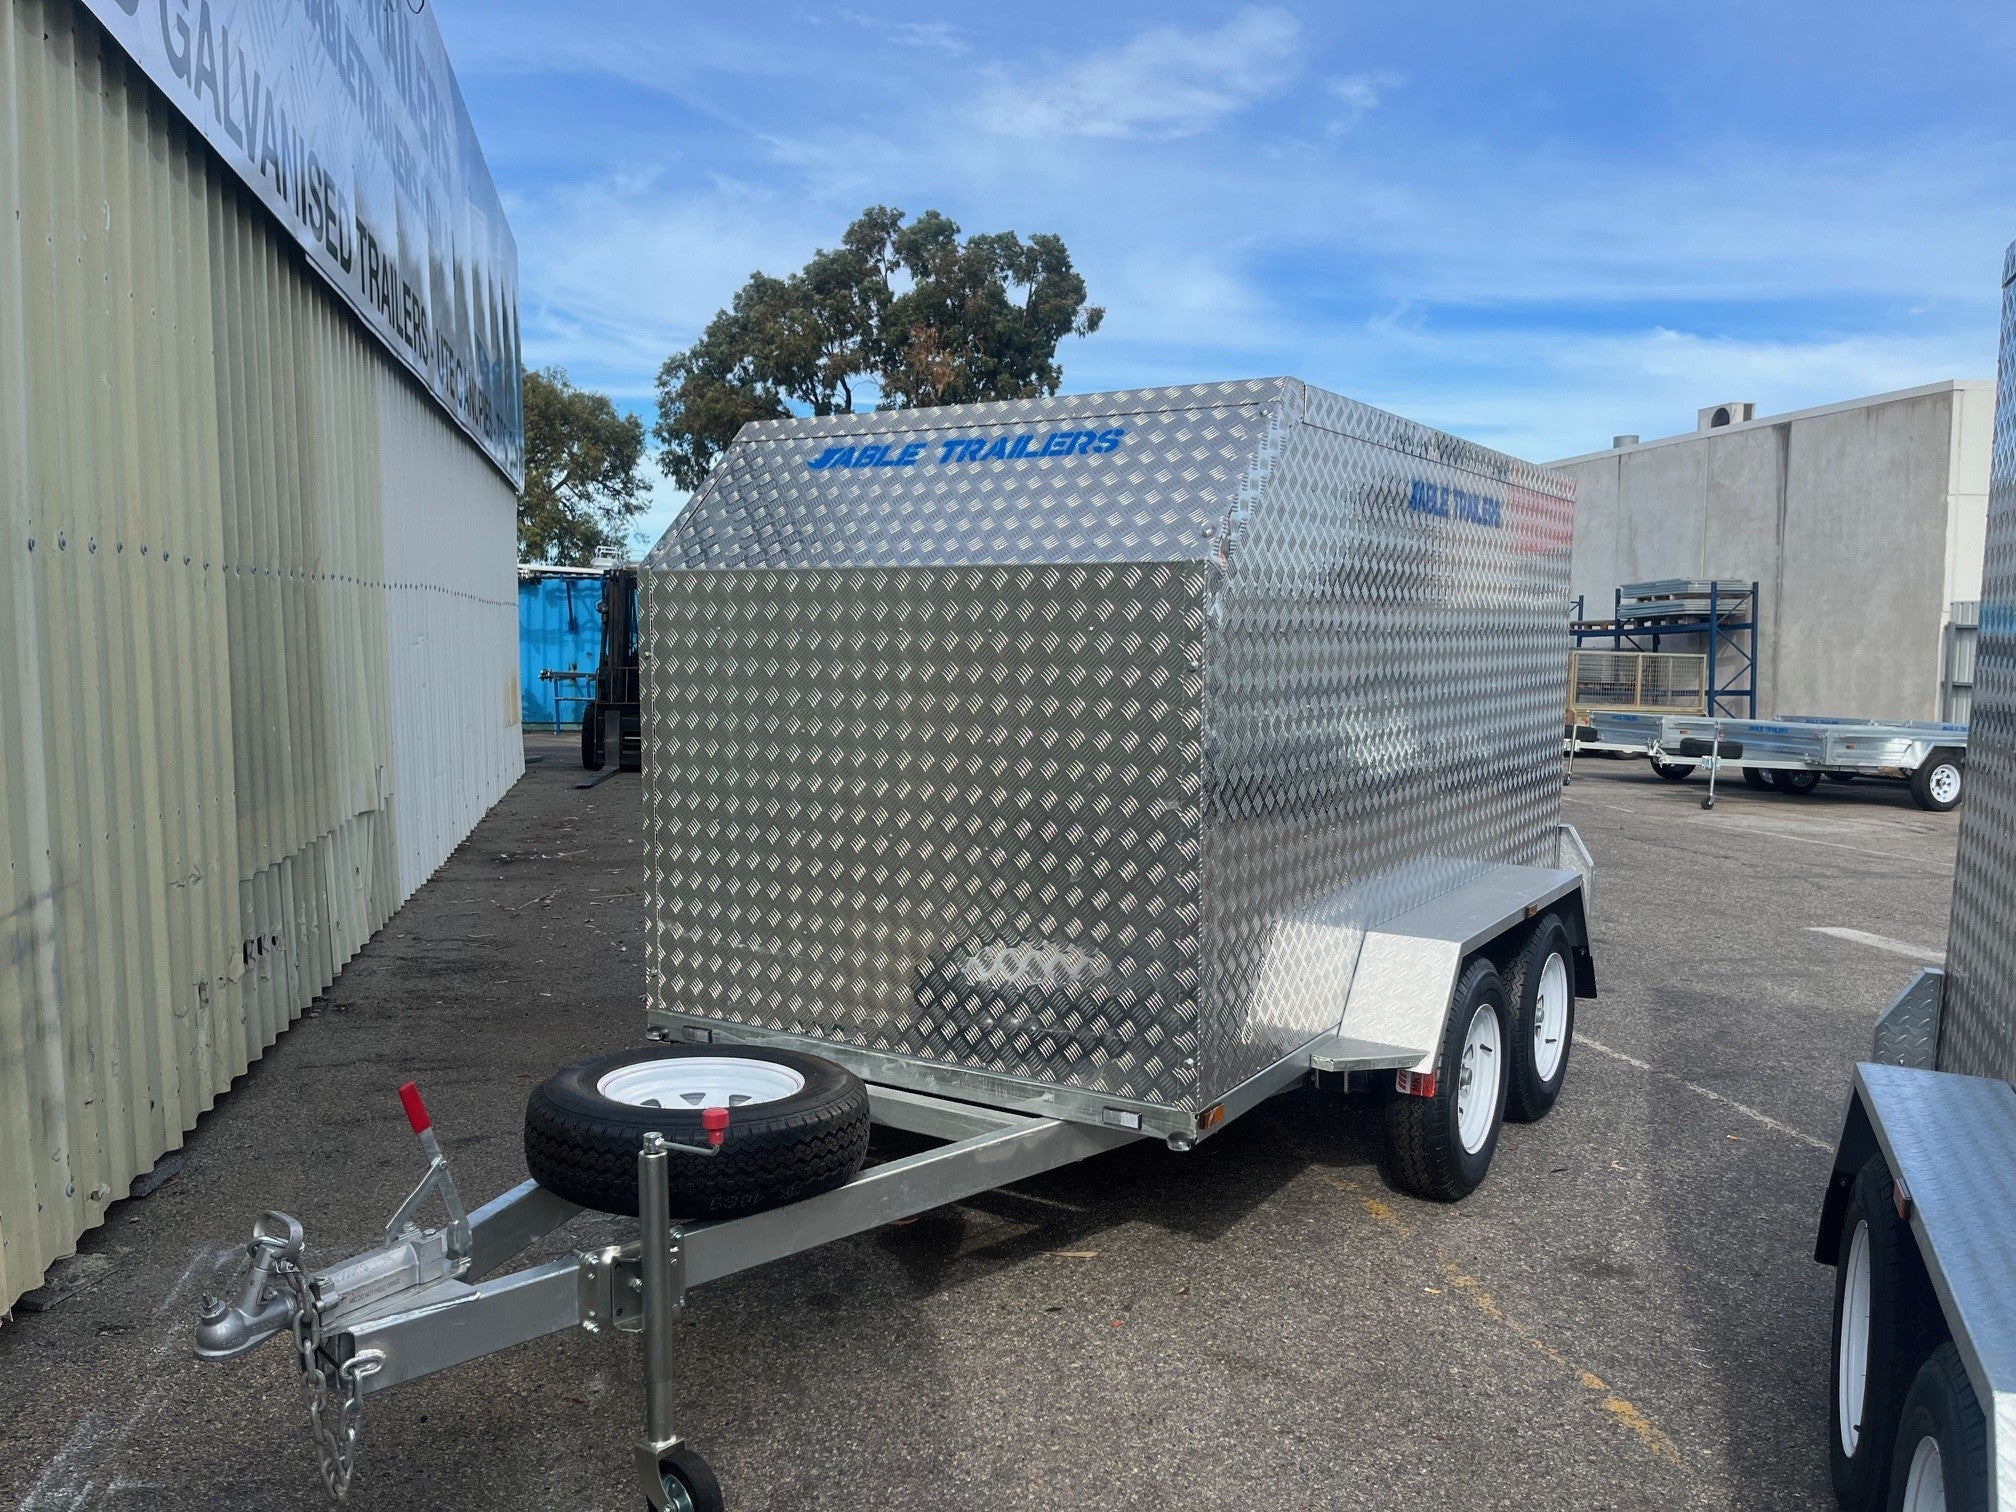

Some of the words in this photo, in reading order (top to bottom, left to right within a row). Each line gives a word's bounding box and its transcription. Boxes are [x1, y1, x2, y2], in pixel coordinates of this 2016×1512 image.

[159, 0, 352, 275] GALVANISED
[355, 214, 429, 367] TRAILERS
[436, 327, 456, 400] UTE
[808, 443, 927, 470] ABLE
[939, 428, 1125, 465] TRAILERS
